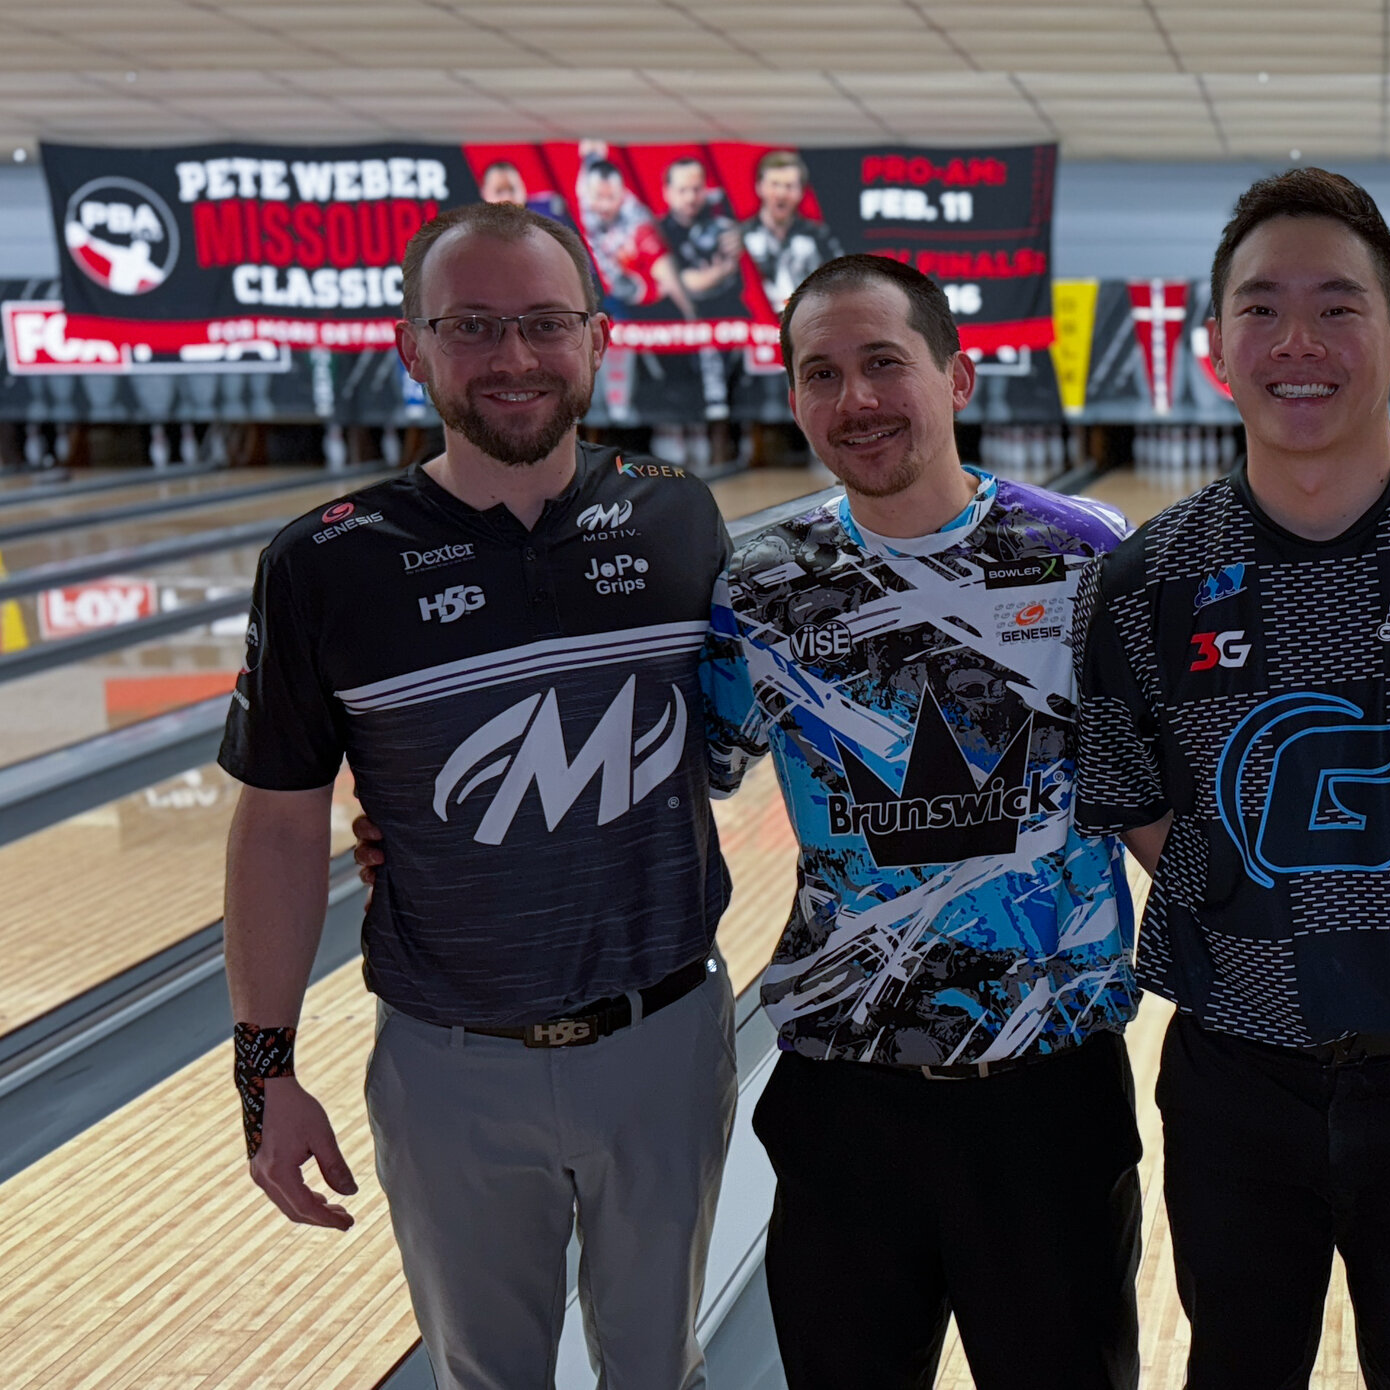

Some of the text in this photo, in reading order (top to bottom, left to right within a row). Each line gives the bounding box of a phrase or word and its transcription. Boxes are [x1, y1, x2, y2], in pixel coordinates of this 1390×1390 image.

[176, 157, 449, 202] PETE WEBER
[81, 201, 163, 237] PBA
[860, 188, 973, 222] FEB. 11
[231, 263, 405, 308] CLASSIC
[615, 455, 686, 478] KYBER
[312, 511, 384, 544] GENESIS
[583, 528, 636, 542] MOTIV
[400, 543, 474, 570] Dexter
[596, 578, 646, 595] Grips
[418, 585, 486, 624] H5G
[1002, 625, 1062, 642] GENESIS
[1189, 630, 1252, 672] 3G
[827, 769, 1063, 836] Brunswick
